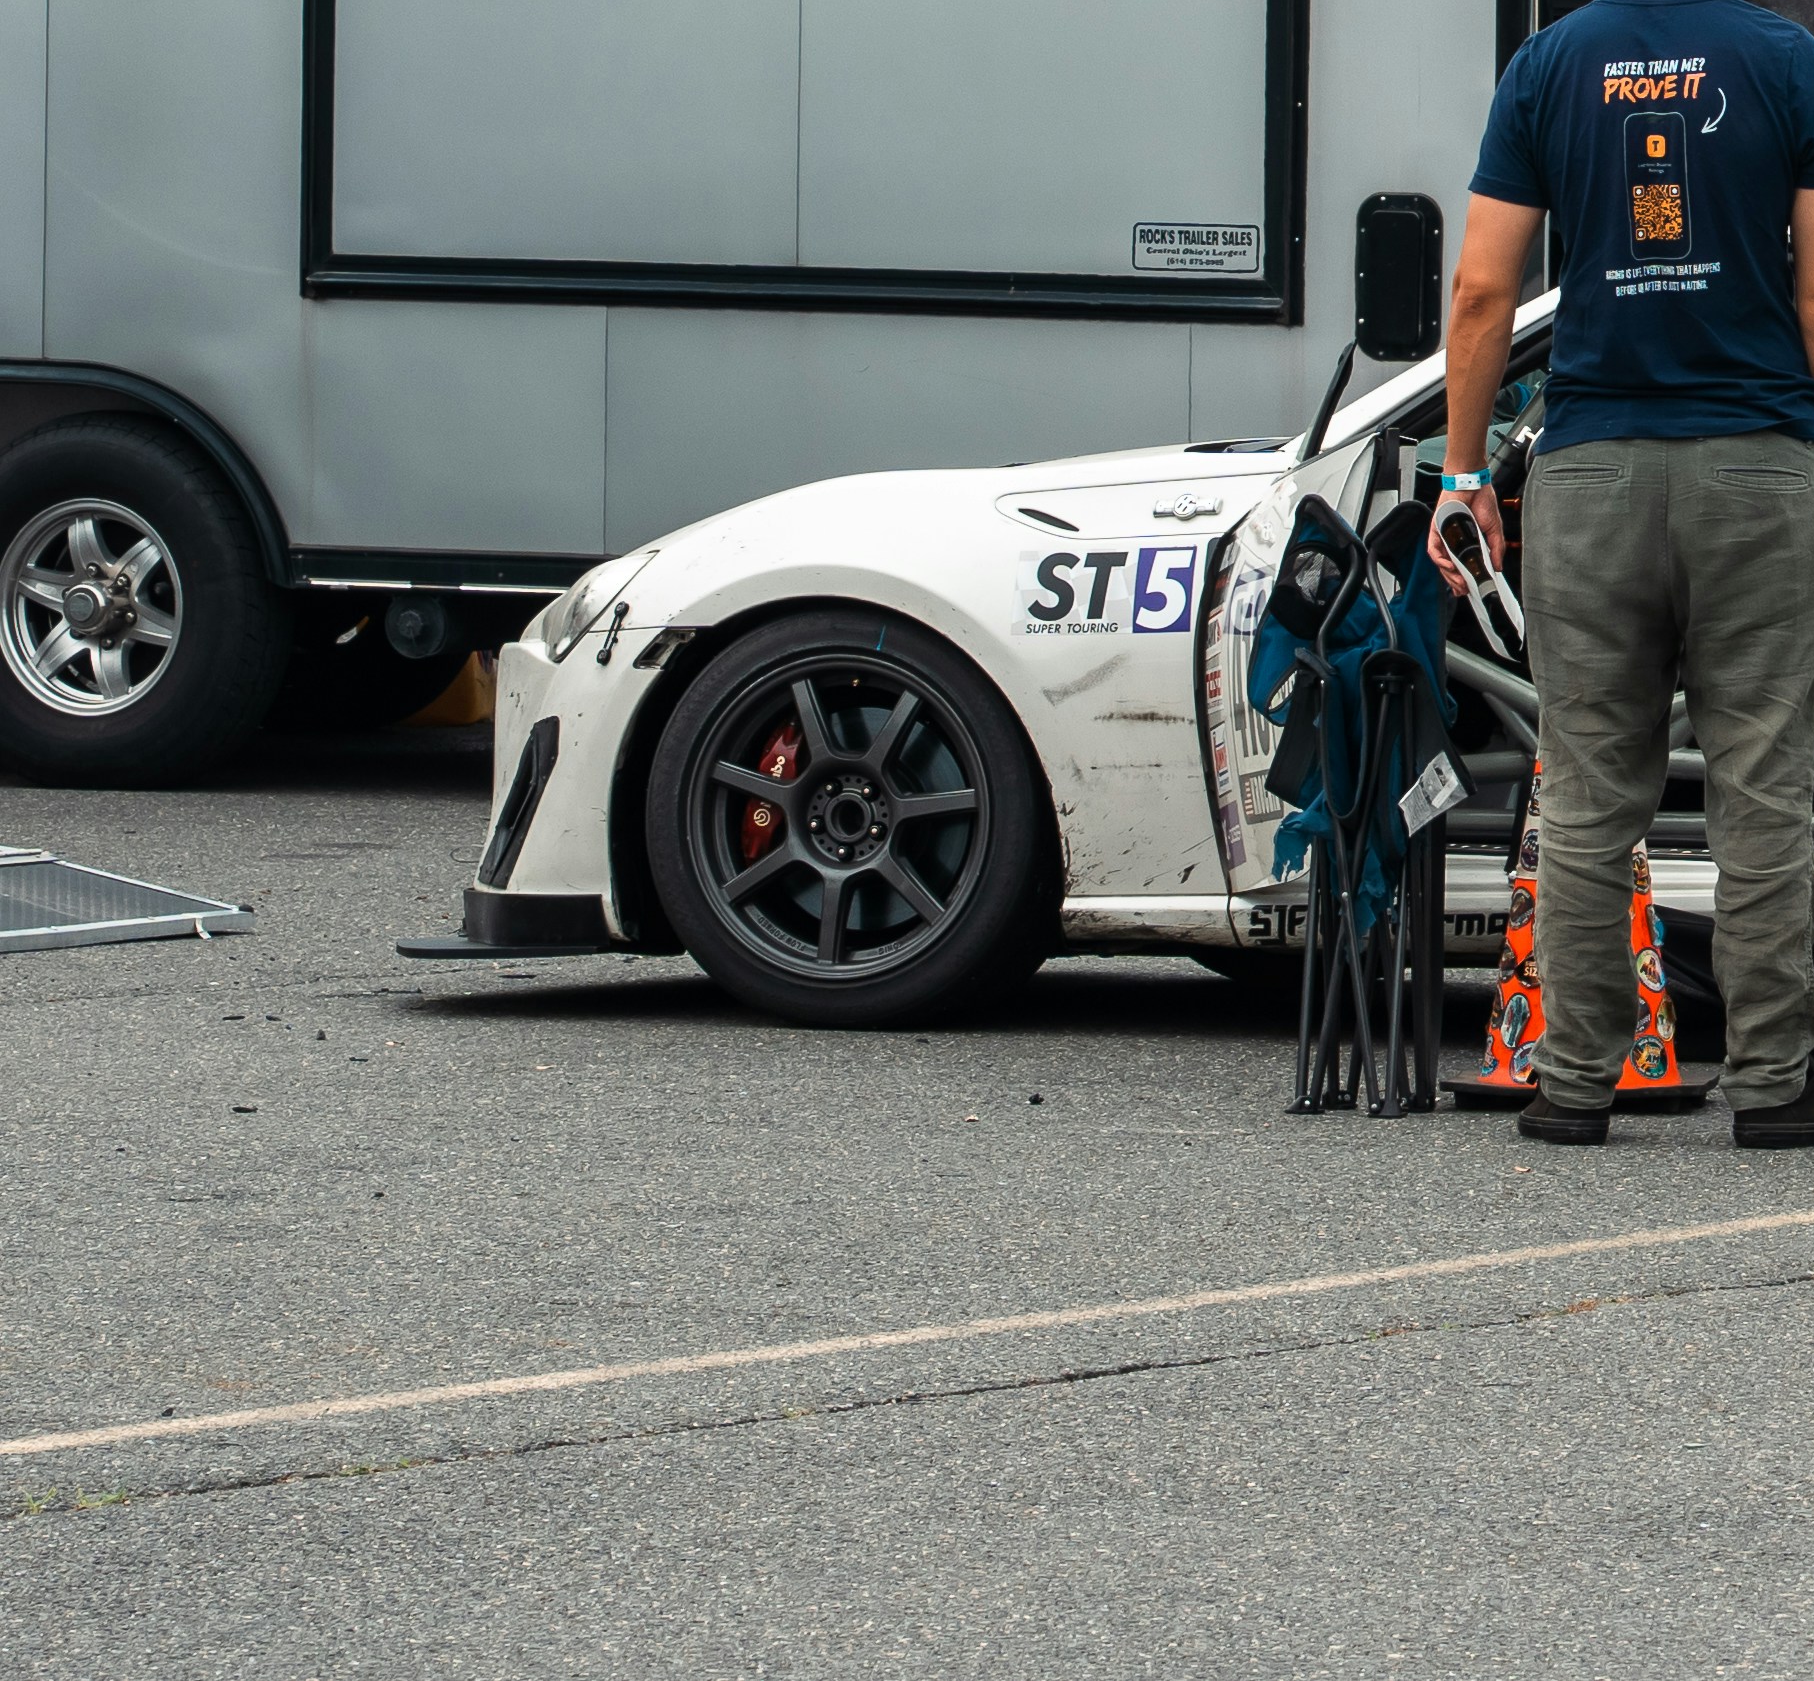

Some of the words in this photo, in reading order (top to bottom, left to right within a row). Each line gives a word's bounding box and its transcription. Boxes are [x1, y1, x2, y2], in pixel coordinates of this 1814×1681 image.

[1603, 61, 1645, 77] FASTER
[1648, 59, 1679, 75] THAN
[1681, 57, 1706, 72] ME?
[1603, 74, 1678, 103] PROVE
[1683, 72, 1706, 99] IT
[1139, 228, 1176, 245] ROCK'S
[1177, 230, 1219, 246] TRAILER
[1221, 230, 1253, 247] SALES
[1146, 246, 1181, 255] Central
[1182, 247, 1210, 256] Ohio's
[1212, 248, 1247, 258] Largest
[1676, 264, 1692, 276] THAT
[1693, 261, 1720, 275] HAPPENS
[1025, 623, 1061, 634] SUPER
[1066, 622, 1119, 634] TOURING
